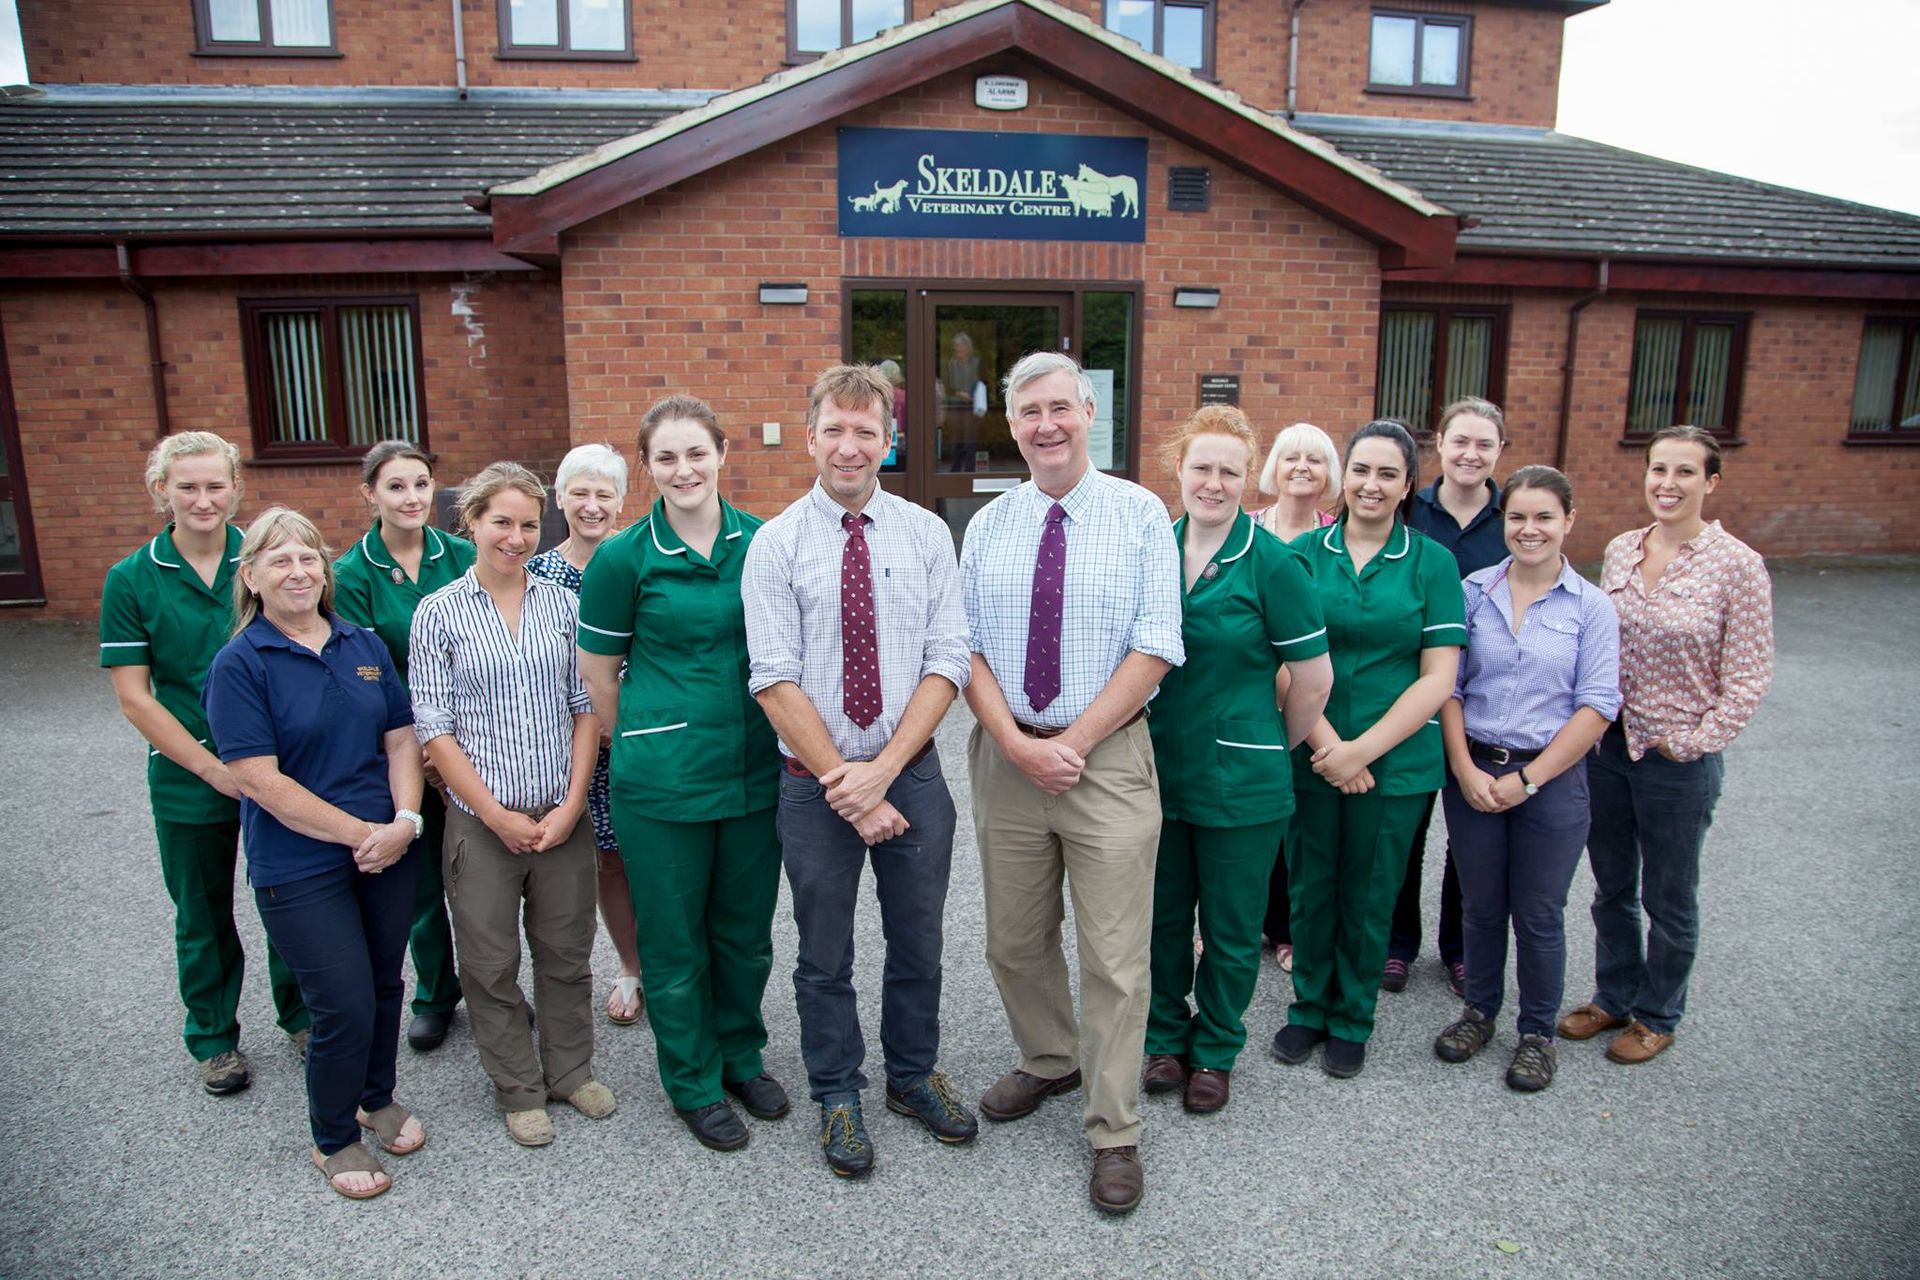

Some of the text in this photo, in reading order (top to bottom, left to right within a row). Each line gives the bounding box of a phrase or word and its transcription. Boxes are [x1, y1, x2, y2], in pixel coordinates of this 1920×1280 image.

[918, 154, 1056, 197] SKELDALE
[907, 198, 1071, 217] VETERINARY CENTRE
